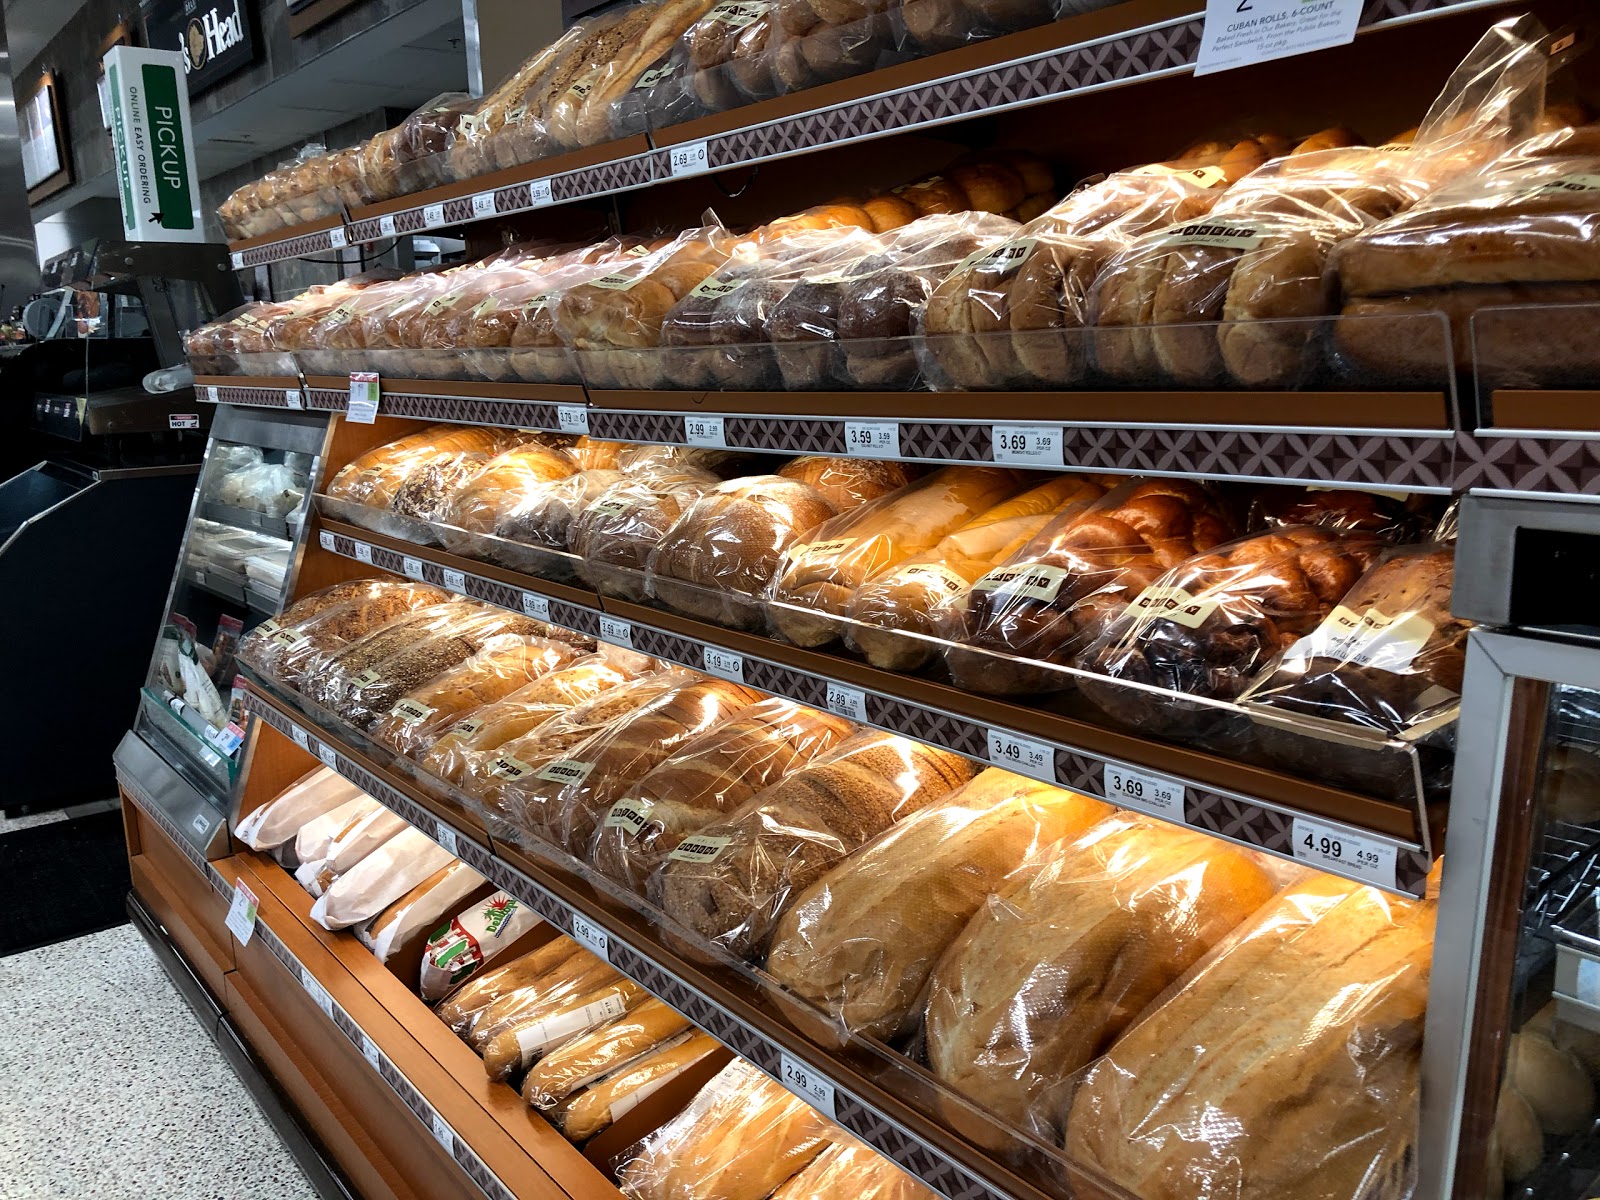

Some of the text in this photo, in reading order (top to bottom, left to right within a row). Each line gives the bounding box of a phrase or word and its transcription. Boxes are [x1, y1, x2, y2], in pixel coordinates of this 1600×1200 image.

[1226, 20, 1258, 33] CUBAN
[1291, 0, 1335, 18] 6-COUNT
[202, 0, 244, 60] Head
[1211, 42, 1234, 53] Perfect
[1266, 32, 1284, 41] From
[1284, 29, 1295, 37] the
[1296, 24, 1316, 35] Publix
[1216, 32, 1236, 44] Baked
[1236, 29, 1253, 40] Fresh
[1261, 25, 1274, 33] Our
[114, 106, 130, 189] PICKUP
[129, 86, 151, 204] ONLINE EASY ORDERING
[154, 105, 181, 190] PICKUP
[560, 412, 572, 423] 3.79
[689, 423, 704, 435] 2.99
[851, 430, 871, 444] 3.59
[878, 432, 891, 440] 3.59
[1000, 434, 1026, 450] 3.69
[1036, 437, 1051, 446] 3.69
[706, 653, 721, 667] 3.19
[829, 691, 846, 706] 2.89
[995, 740, 1020, 759] 3.49
[1029, 751, 1043, 762] 3.49
[1113, 775, 1143, 797] 3.69
[1154, 788, 1172, 801] 3.69
[1303, 833, 1342, 858] 4.99
[1356, 850, 1379, 863] 4.99
[786, 1065, 807, 1088] 2.99
